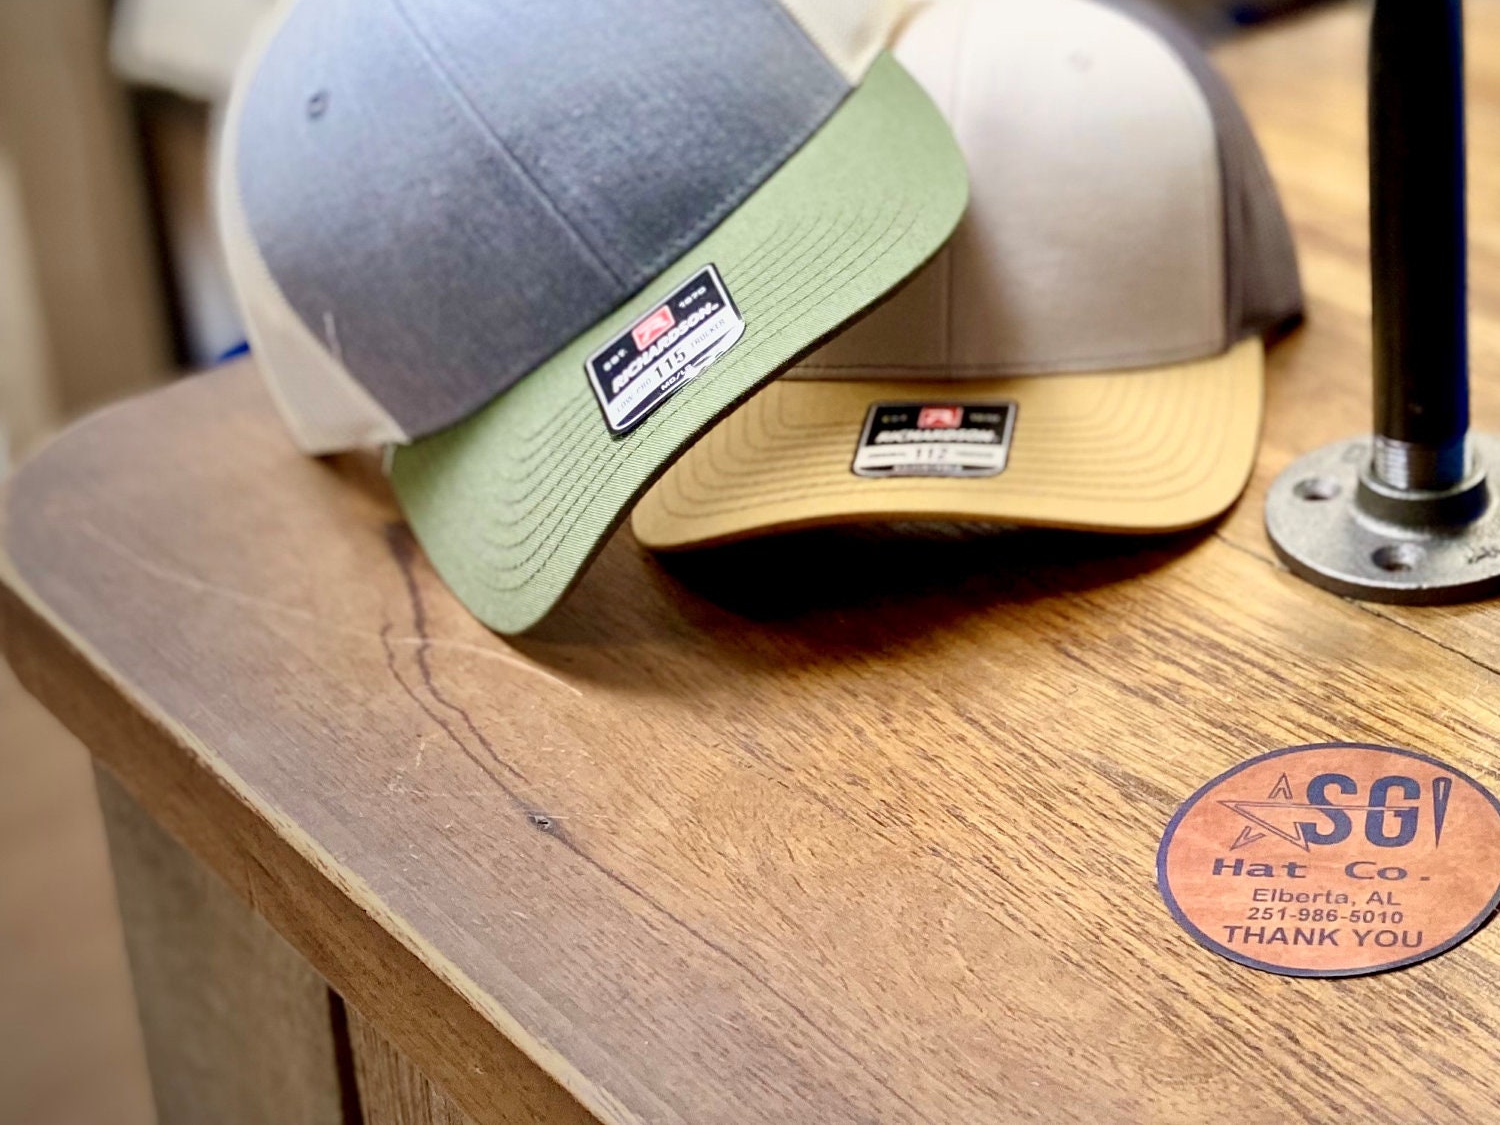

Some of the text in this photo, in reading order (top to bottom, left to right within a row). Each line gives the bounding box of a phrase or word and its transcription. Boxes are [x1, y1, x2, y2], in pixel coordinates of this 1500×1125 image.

[612, 301, 716, 394] RICHARDSON
[654, 349, 687, 379] 115
[1212, 858, 1431, 881] Hat Co.
[1252, 888, 1401, 906] Elberta, AL
[1246, 907, 1404, 924] 251-986-5010
[1223, 926, 1424, 949] THANK YOU
